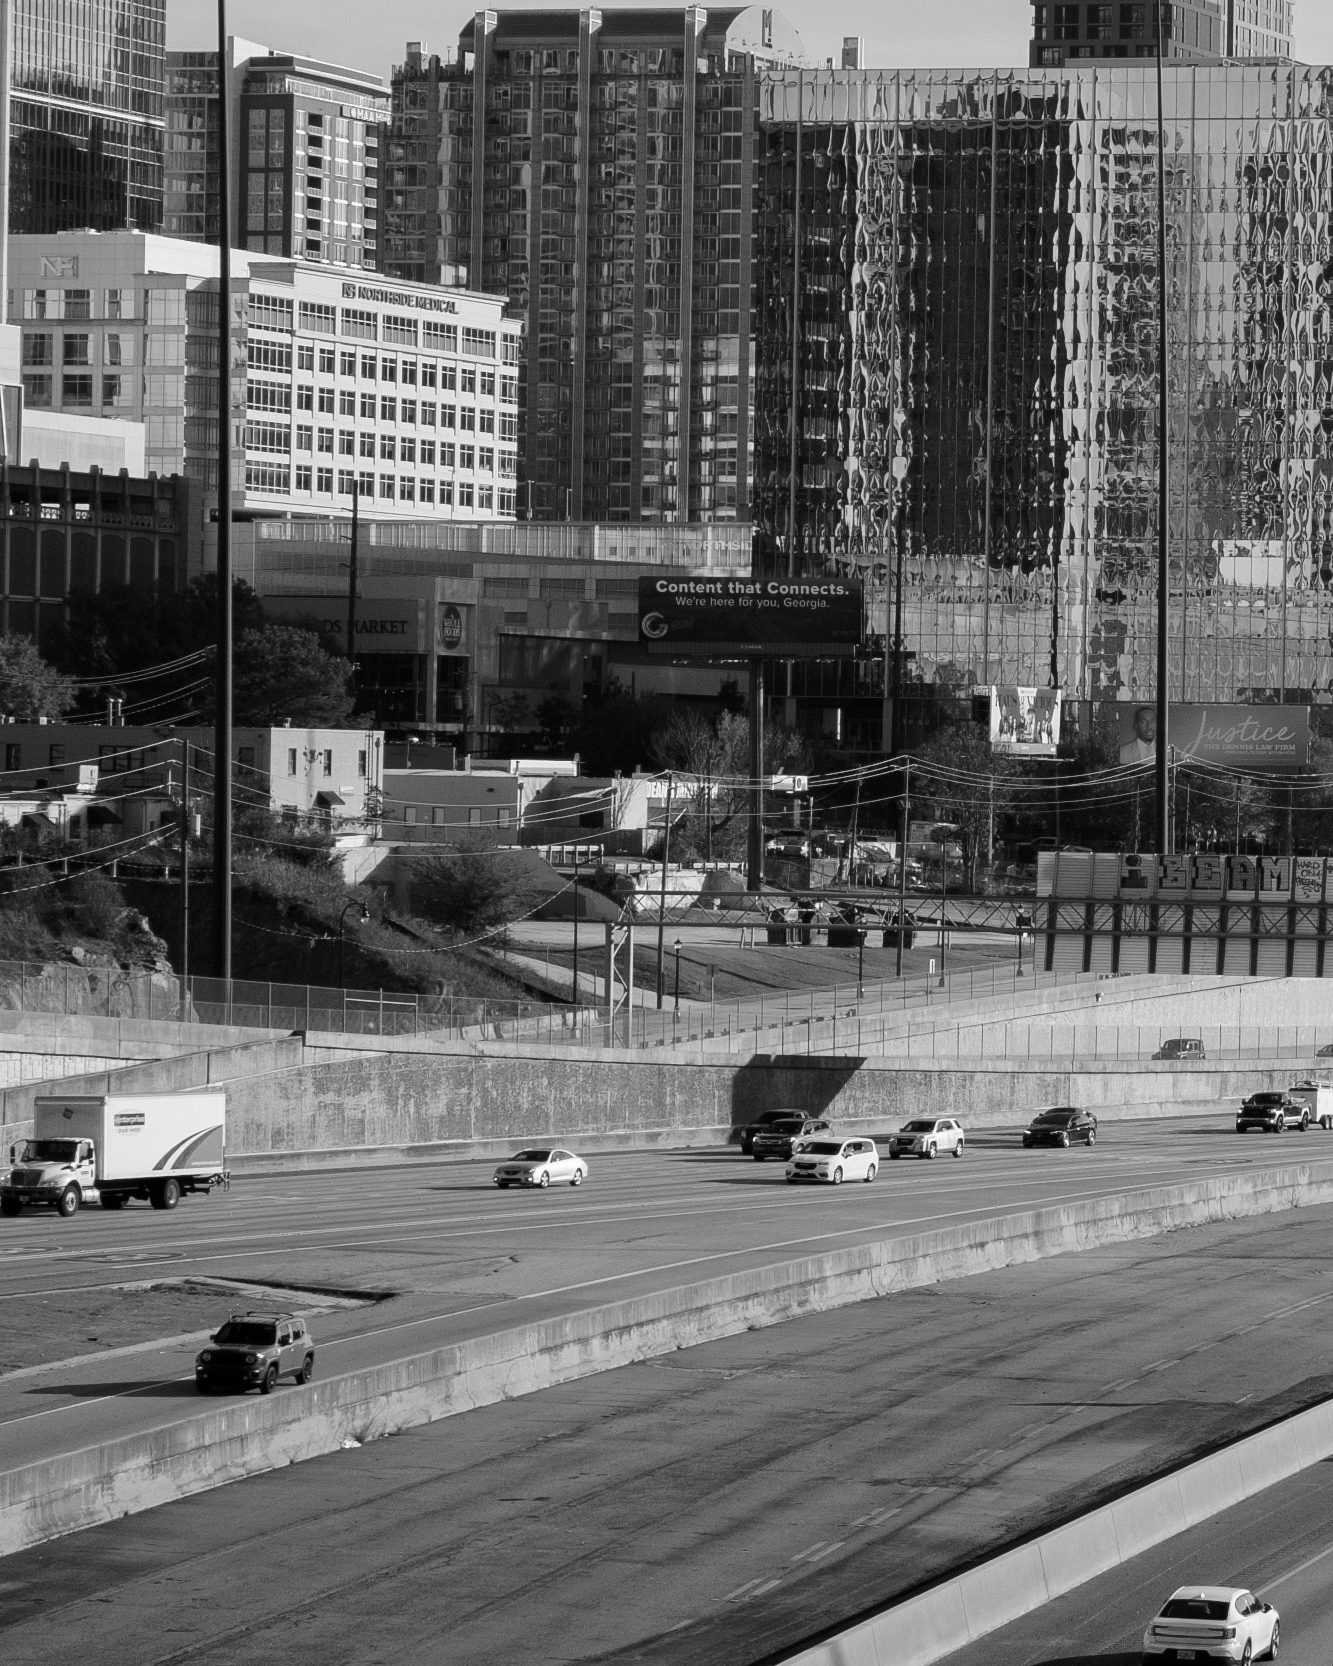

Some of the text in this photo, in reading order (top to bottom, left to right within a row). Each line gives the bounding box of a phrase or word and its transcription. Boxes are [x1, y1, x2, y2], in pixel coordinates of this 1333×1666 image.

[656, 580, 849, 595] Content that Connects.
[676, 596, 830, 609] We're here for you, Georgia.
[1183, 711, 1296, 758] Justice
